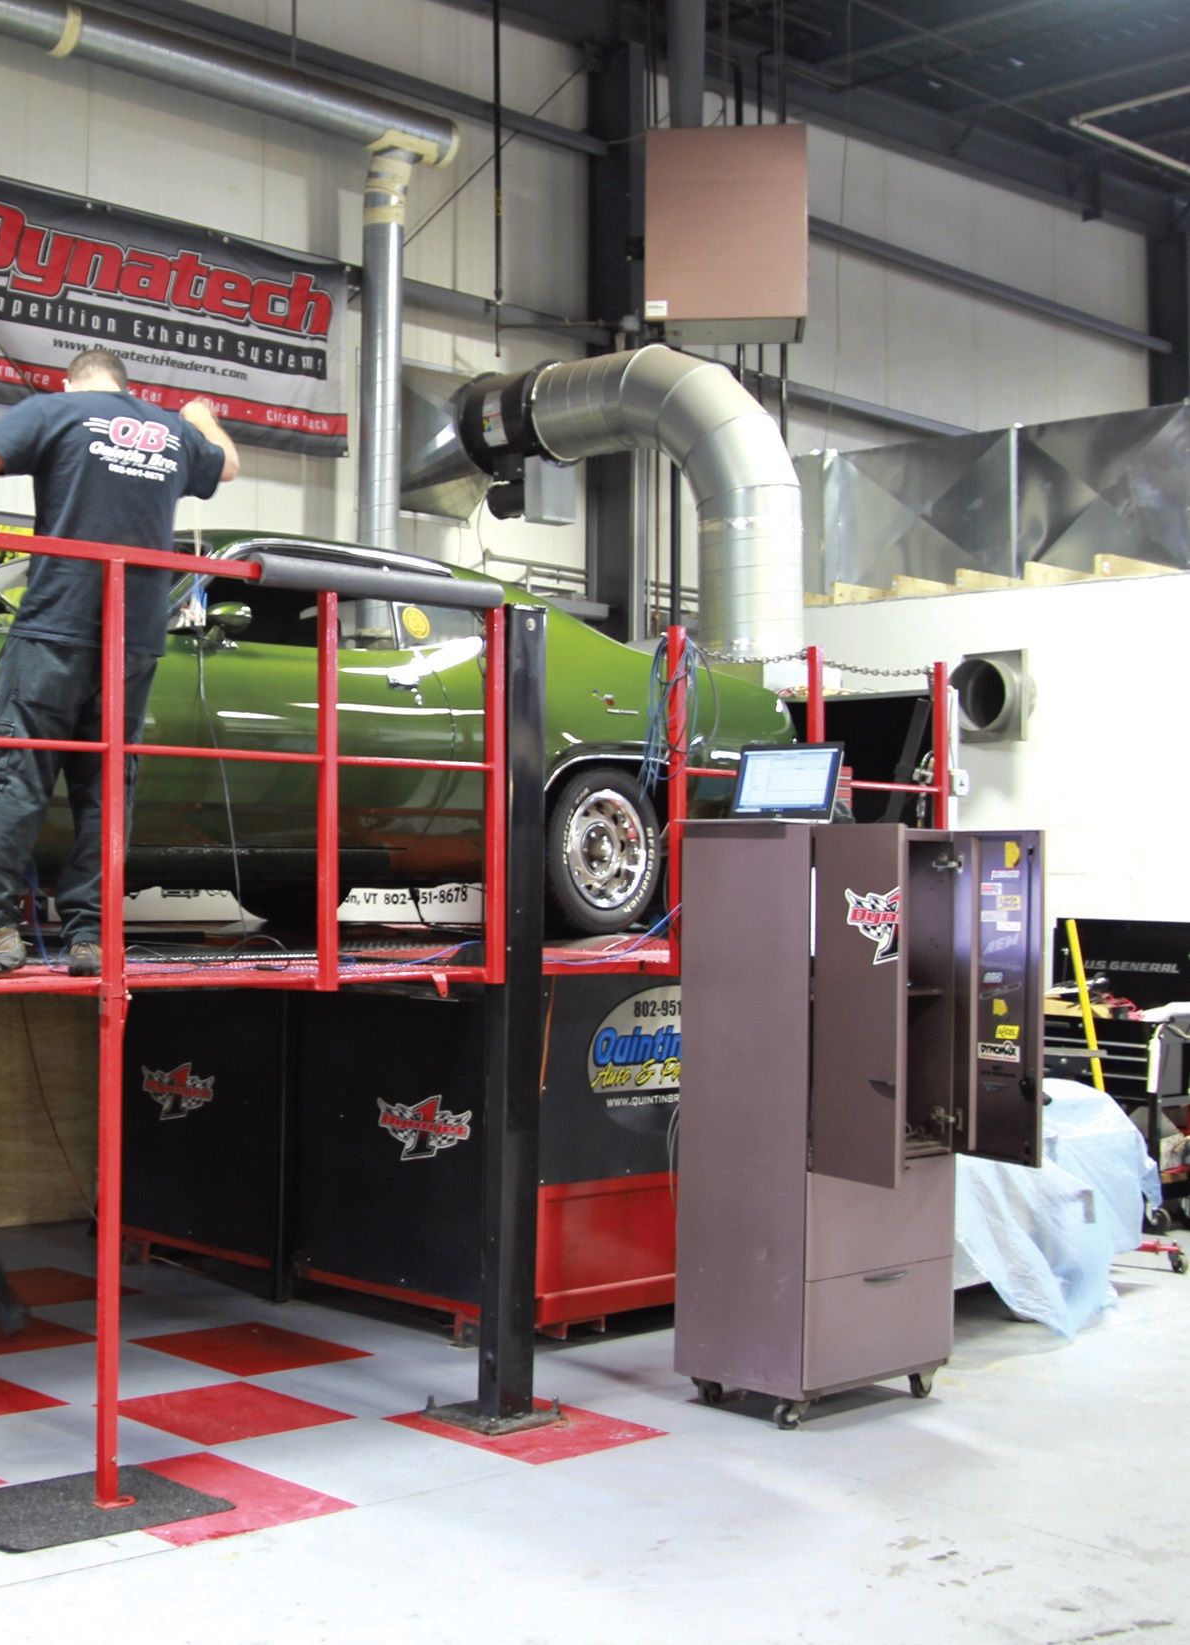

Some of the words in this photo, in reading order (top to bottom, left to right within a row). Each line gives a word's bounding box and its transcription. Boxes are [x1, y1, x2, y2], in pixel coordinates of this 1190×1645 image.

[133, 320, 225, 353] Exhaust
[108, 416, 170, 453] QB
[622, 826, 655, 914] BFGoodrich
[364, 892, 379, 904] VT
[384, 885, 468, 905] 802-51-8678
[1109, 961, 1180, 974] GENERAL
[590, 1062, 632, 1089] Auto
[635, 1059, 656, 1087] &
